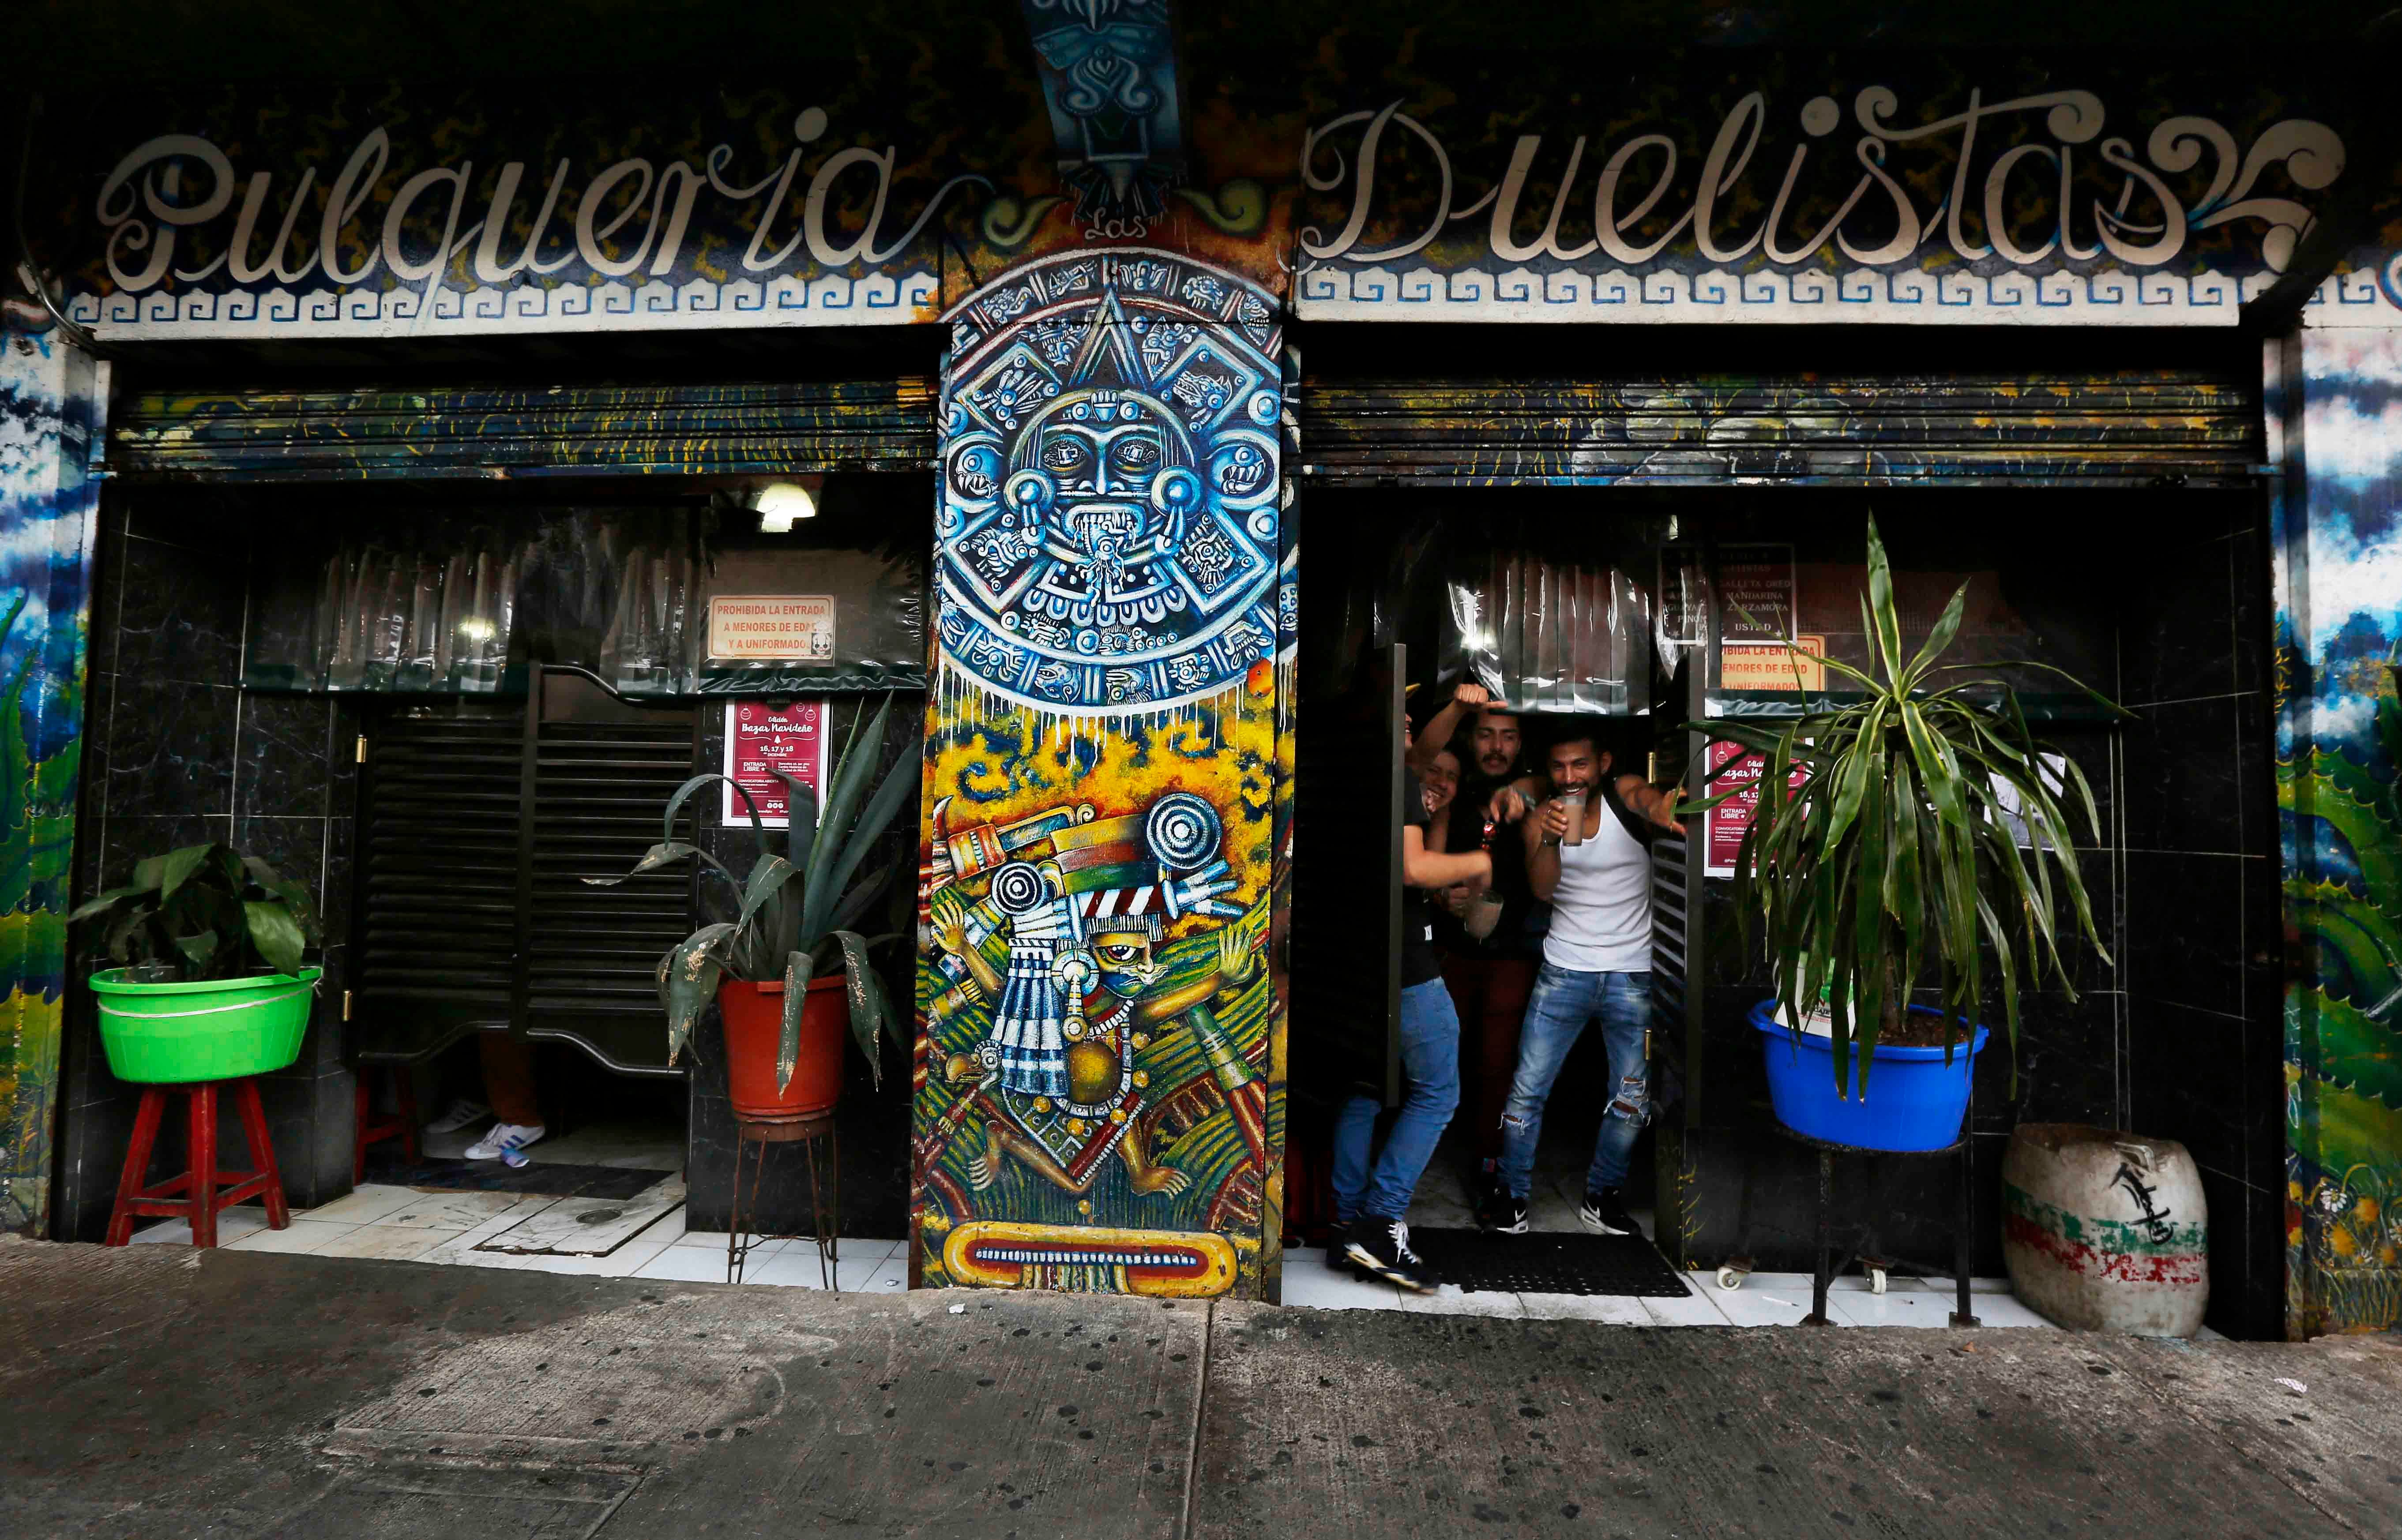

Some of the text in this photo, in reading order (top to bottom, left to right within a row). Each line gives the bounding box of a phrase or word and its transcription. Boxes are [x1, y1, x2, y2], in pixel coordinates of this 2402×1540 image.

[1300, 85, 2189, 267] Duelistas
[96, 106, 991, 327] Pulqueria
[1085, 207, 1147, 240] Las
[718, 605, 825, 615] PROHIBIDA LA ENTRADA
[1726, 603, 1789, 611] ZRZAMORA
[724, 623, 730, 631] A
[733, 623, 777, 631] MENORES
[779, 623, 791, 631] DE
[729, 639, 810, 648] Y A UNIFORMADO
[1754, 646, 1766, 655] LA
[1722, 663, 1762, 673] ENORES
[1766, 664, 1778, 673] DE
[742, 723, 813, 734] Bazar Navideño
[1722, 769, 1750, 780] azar
